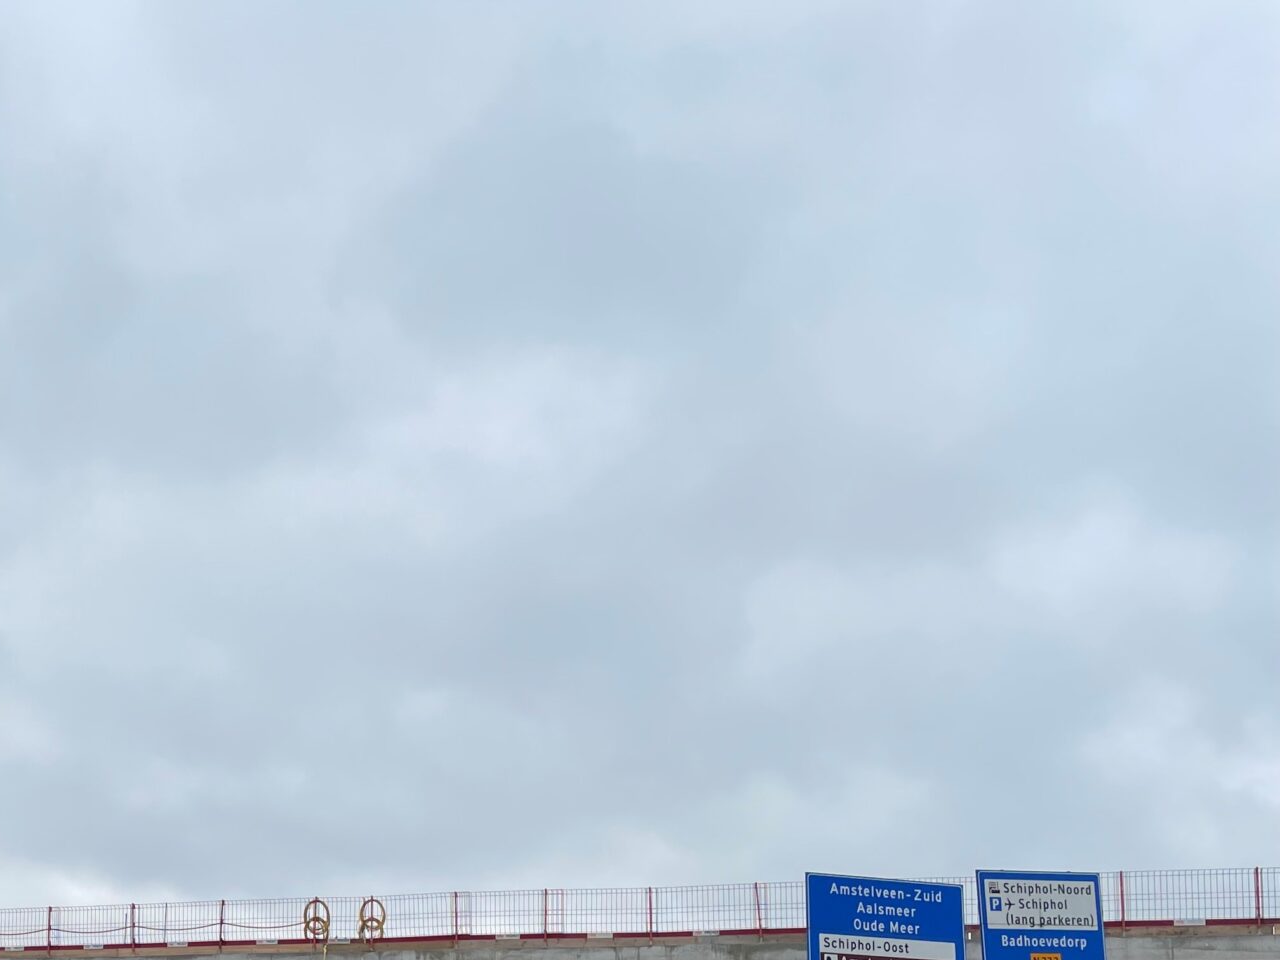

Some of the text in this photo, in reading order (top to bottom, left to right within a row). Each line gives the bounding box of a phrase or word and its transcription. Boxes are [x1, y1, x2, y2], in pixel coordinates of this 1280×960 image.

[829, 882, 942, 903] Amstelveen-Zuid
[1003, 882, 1092, 896] Schiphol-Noord
[856, 902, 917, 918] Aalsmeer
[1018, 898, 1068, 912] Schiphol
[853, 918, 920, 935] Oude Meer
[1006, 912, 1095, 928] (lang parkeren)
[823, 937, 910, 954] Schiphol-Oost
[1001, 934, 1088, 951] Badhoevedorp
